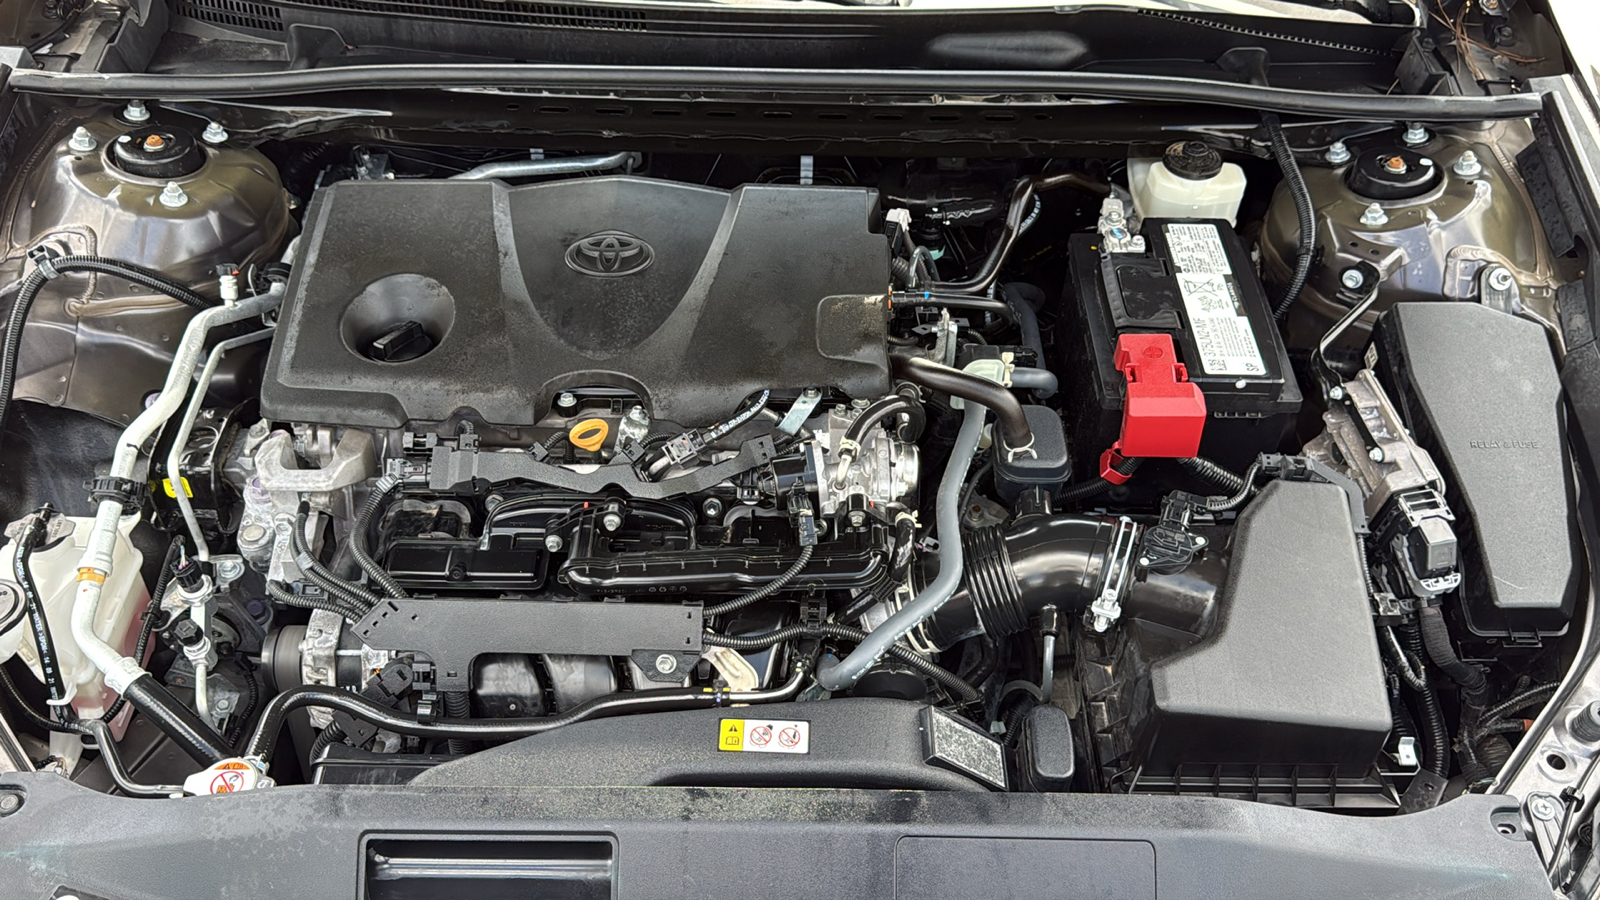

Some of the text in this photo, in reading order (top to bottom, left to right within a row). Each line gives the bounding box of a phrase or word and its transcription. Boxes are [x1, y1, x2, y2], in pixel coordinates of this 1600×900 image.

[1245, 362, 1259, 372] SP
[1469, 440, 1500, 449] RELAY
[1512, 440, 1538, 449] FUSE
[32, 611, 42, 632] WATER
